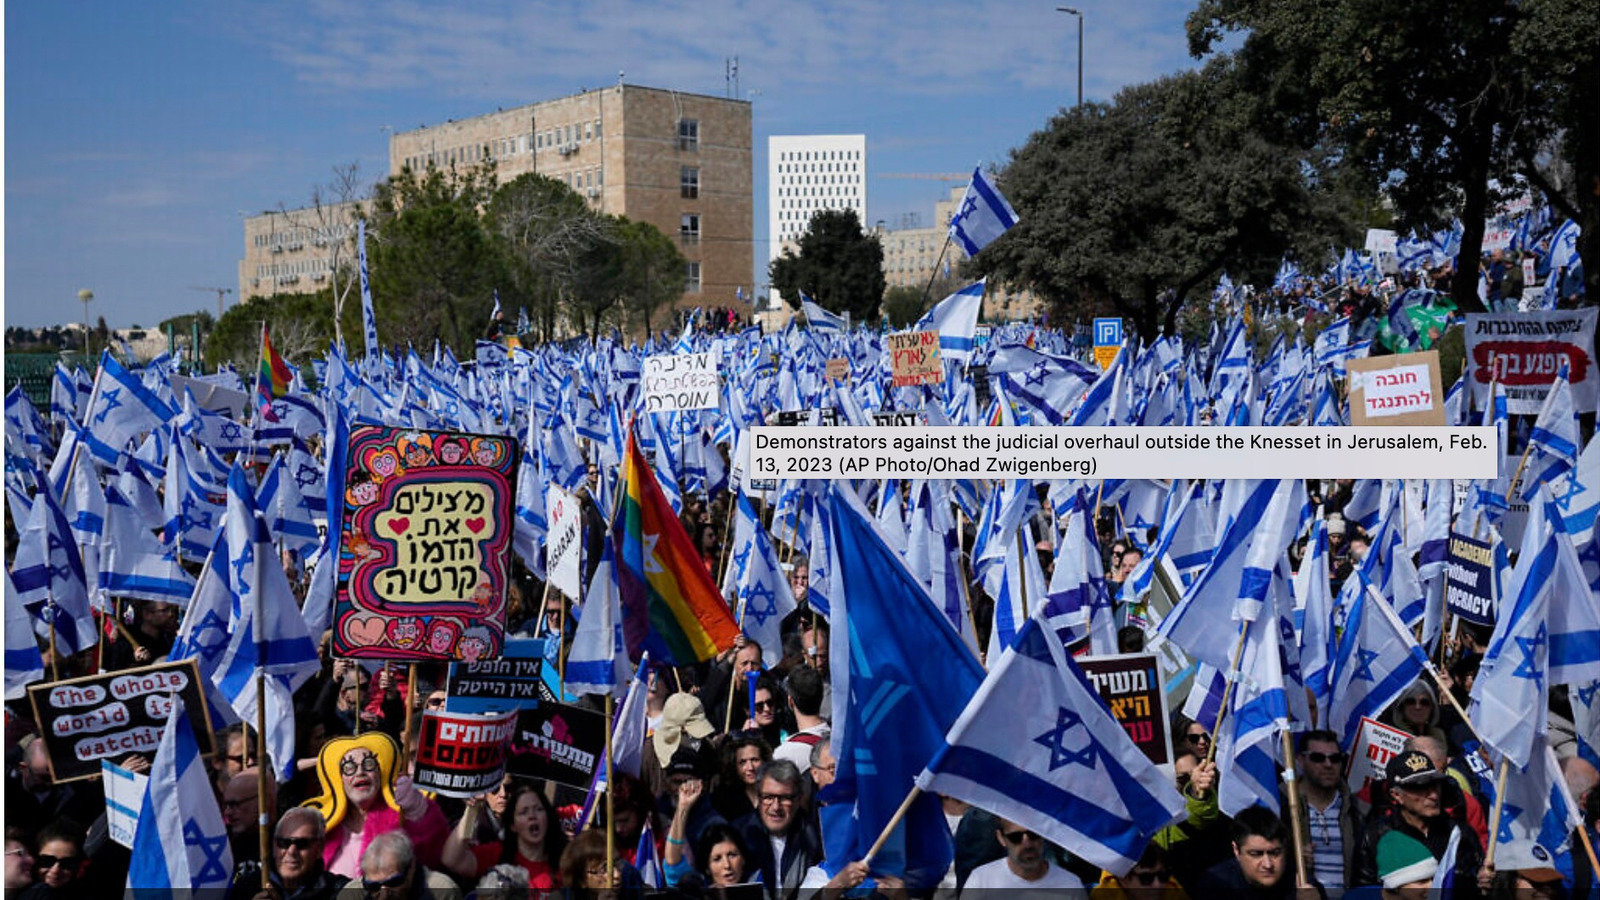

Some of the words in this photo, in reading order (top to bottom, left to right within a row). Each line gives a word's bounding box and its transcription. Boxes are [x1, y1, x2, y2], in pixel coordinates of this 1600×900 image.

[649, 354, 708, 372] מדינה
[1375, 371, 1417, 386] חובה
[647, 391, 709, 412] מוסרית
[1366, 390, 1430, 409] להתנגד
[395, 486, 486, 514] מצילים
[417, 518, 461, 536] את
[385, 565, 477, 599] קרטיה
[467, 659, 511, 674] חופש
[515, 660, 540, 676] אין
[54, 688, 98, 705] The
[114, 673, 181, 696] whole
[457, 680, 506, 696] הייטק
[510, 682, 535, 697] אין
[1110, 695, 1151, 719] היא
[56, 708, 126, 732] world
